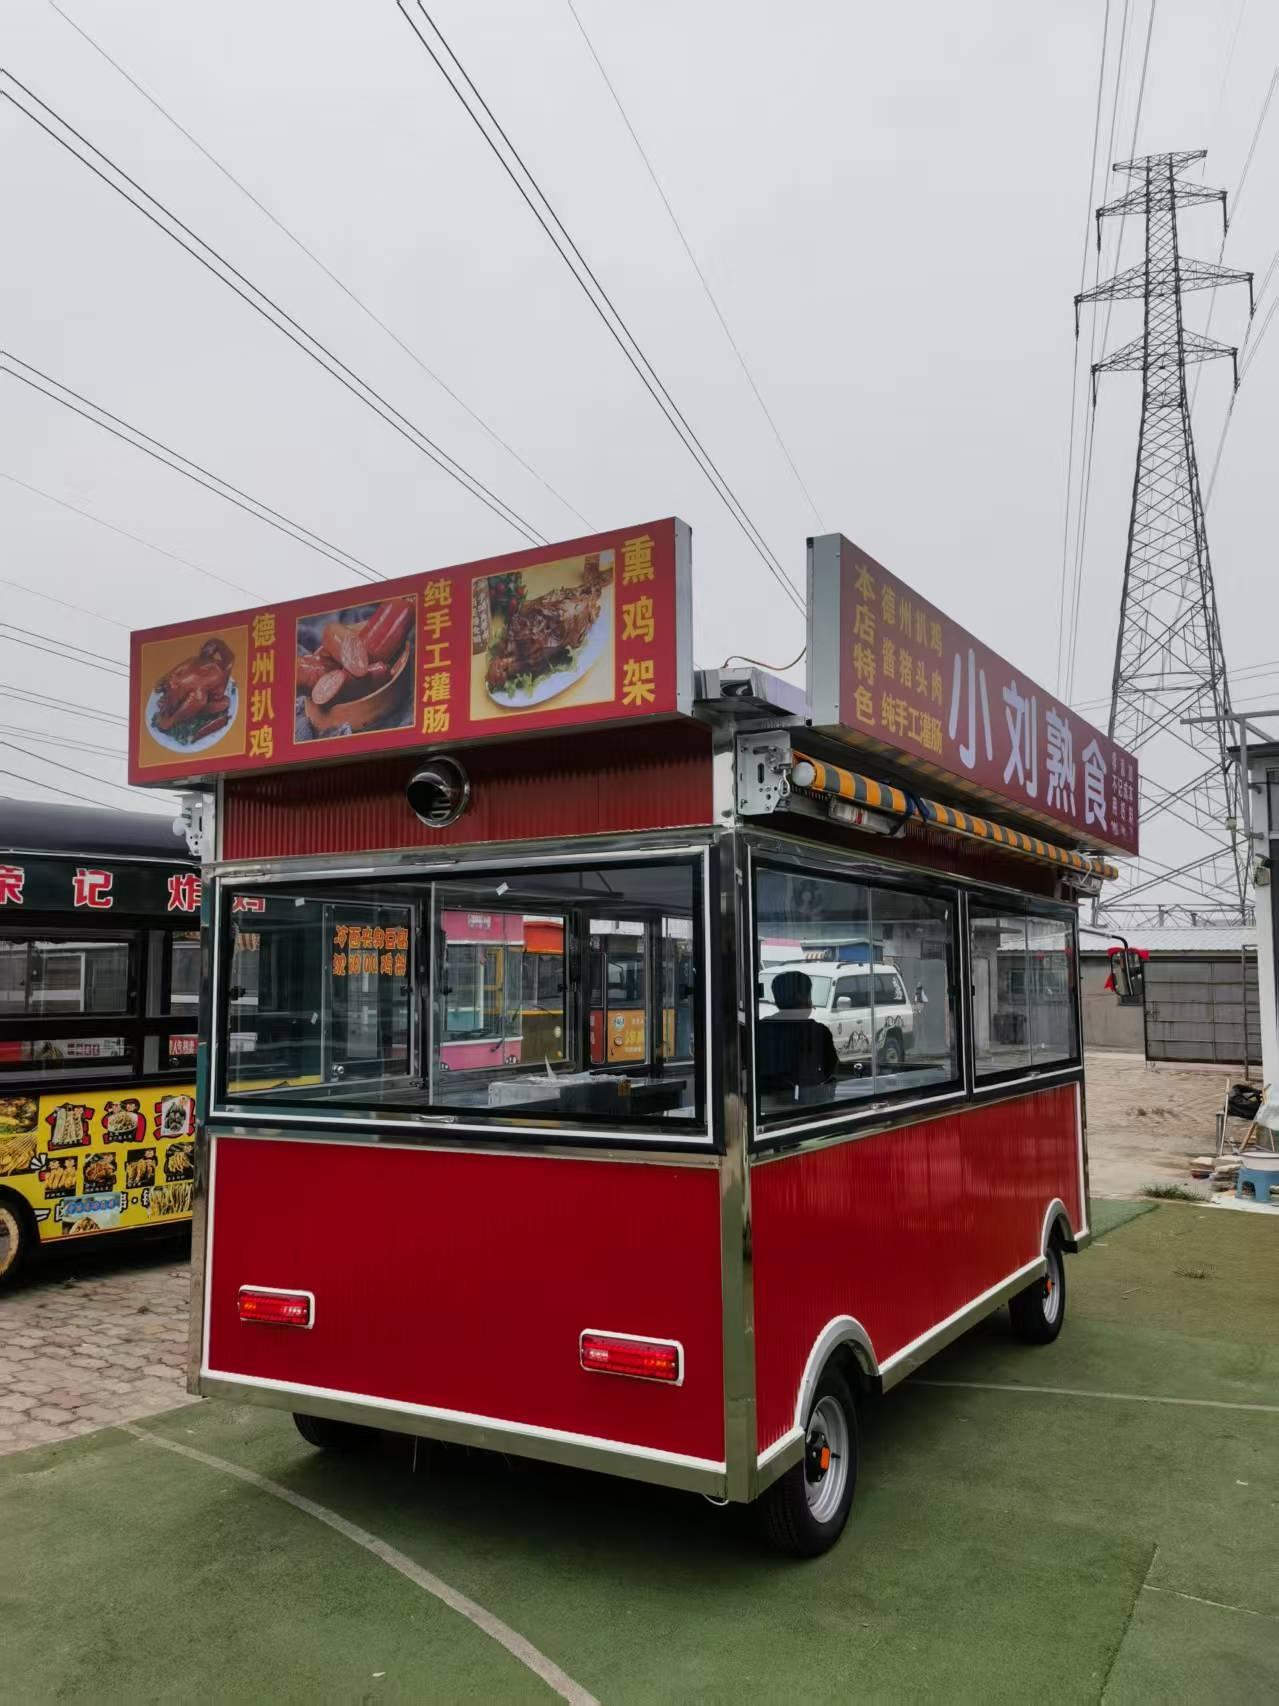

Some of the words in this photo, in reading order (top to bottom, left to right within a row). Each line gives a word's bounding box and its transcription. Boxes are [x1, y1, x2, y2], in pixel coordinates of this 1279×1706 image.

[249, 613, 276, 759] 德州扒鸡
[421, 578, 452, 734] 纯手工灌肠
[621, 534, 656, 706] 熏鸡架
[853, 564, 876, 727] 本店特色
[881, 584, 943, 657] 德州扒鸡
[882, 637, 943, 706] 酱猪头肉
[881, 692, 943, 755] 纯手工灌肠
[948, 648, 1107, 832] 小刘熟食
